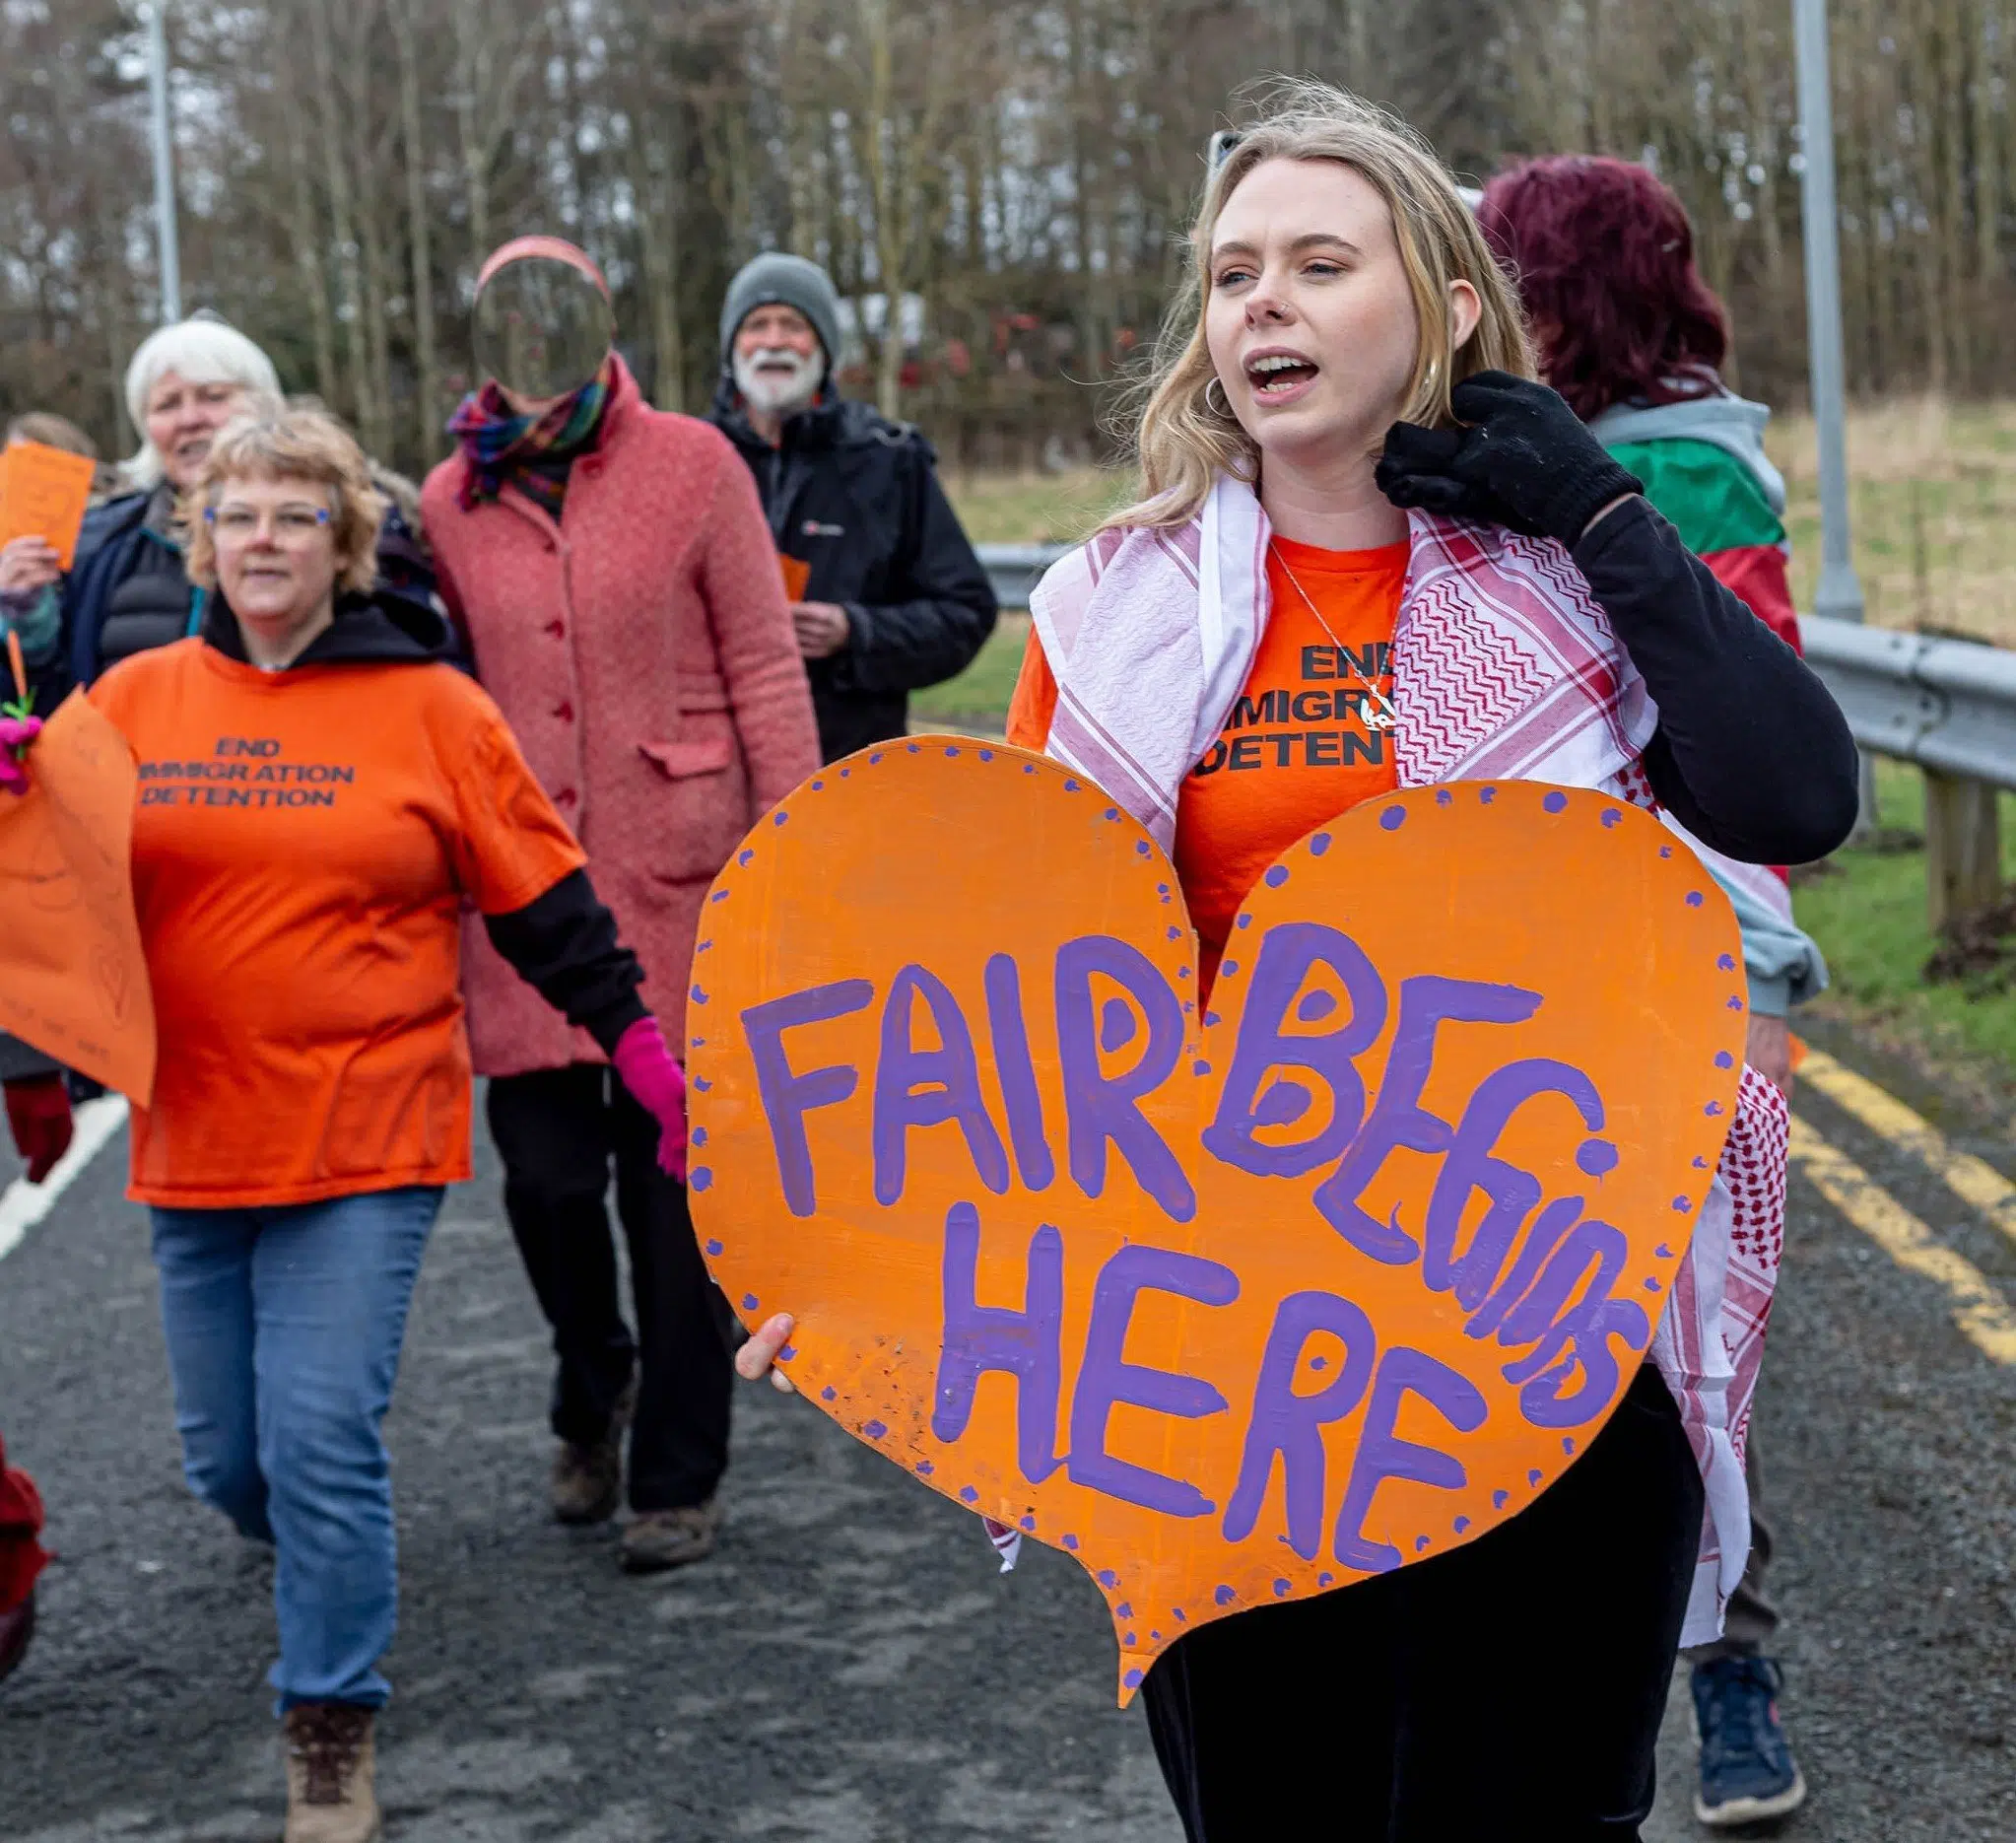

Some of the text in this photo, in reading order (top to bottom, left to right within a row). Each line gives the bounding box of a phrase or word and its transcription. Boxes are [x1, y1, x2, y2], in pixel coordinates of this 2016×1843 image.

[214, 737, 281, 758] END
[1192, 729, 1394, 777] DETEN
[141, 785, 335, 807] DETENTION
[741, 935, 1196, 1223] FAIR
[931, 1200, 1488, 1575] HERE
